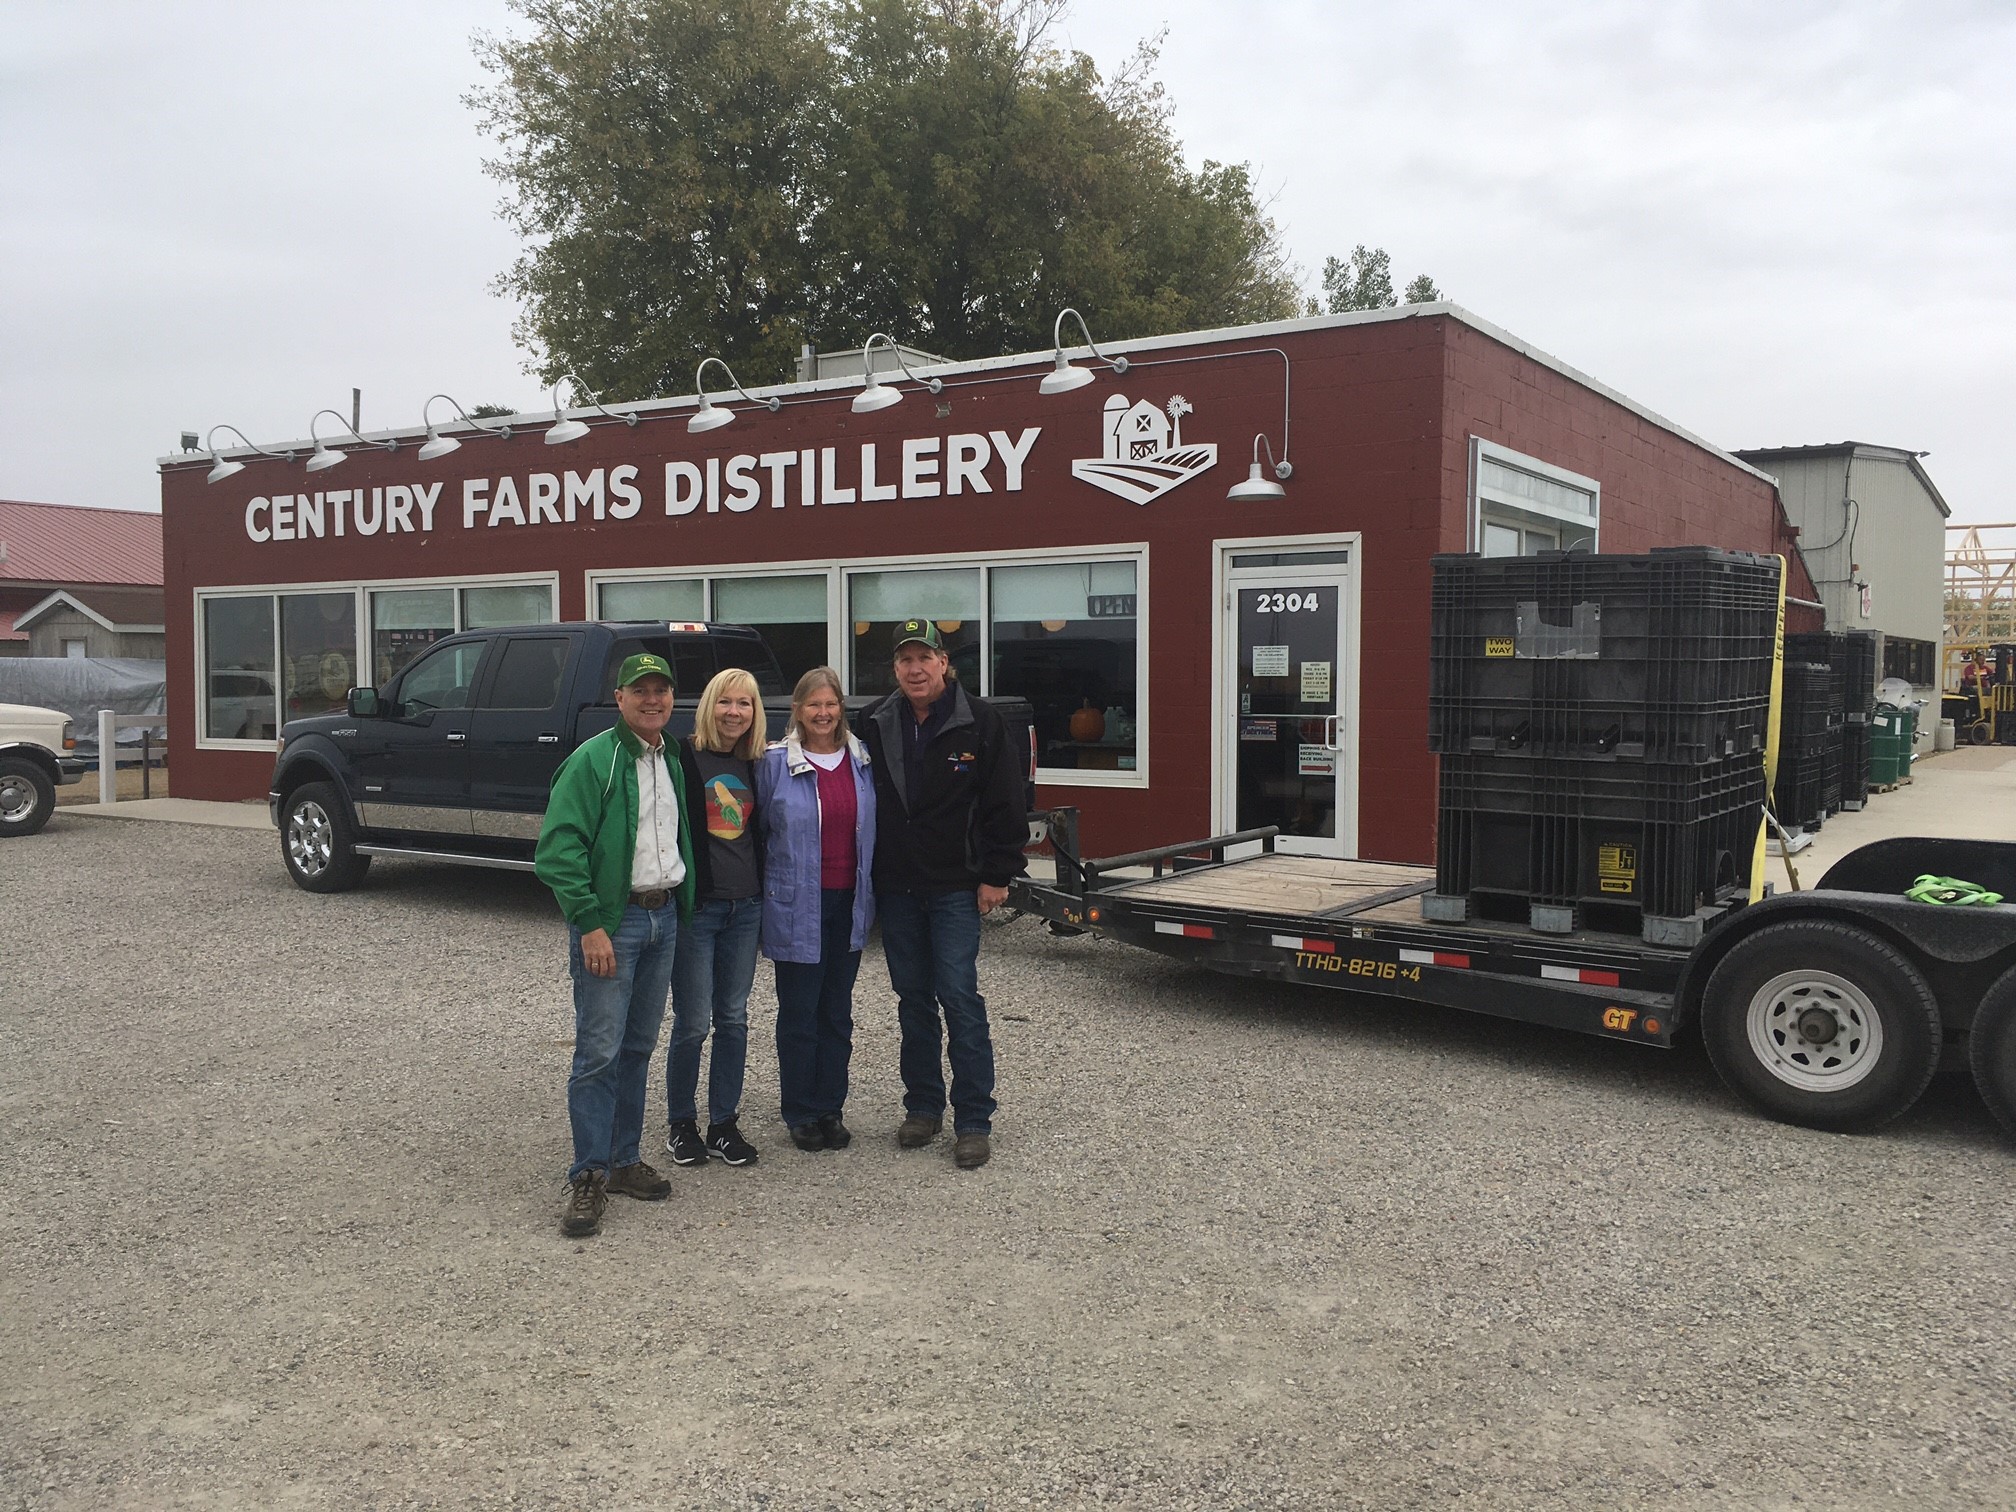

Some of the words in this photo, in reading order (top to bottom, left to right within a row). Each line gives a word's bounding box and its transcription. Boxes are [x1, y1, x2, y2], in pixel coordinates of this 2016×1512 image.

[245, 482, 444, 542] CENTURY
[463, 464, 642, 529] FARMS
[665, 427, 1042, 516] DISTILLERY
[1256, 592, 1319, 613] 2304
[1775, 604, 1785, 661] KEEPER
[1602, 1006, 1638, 1032] GT
